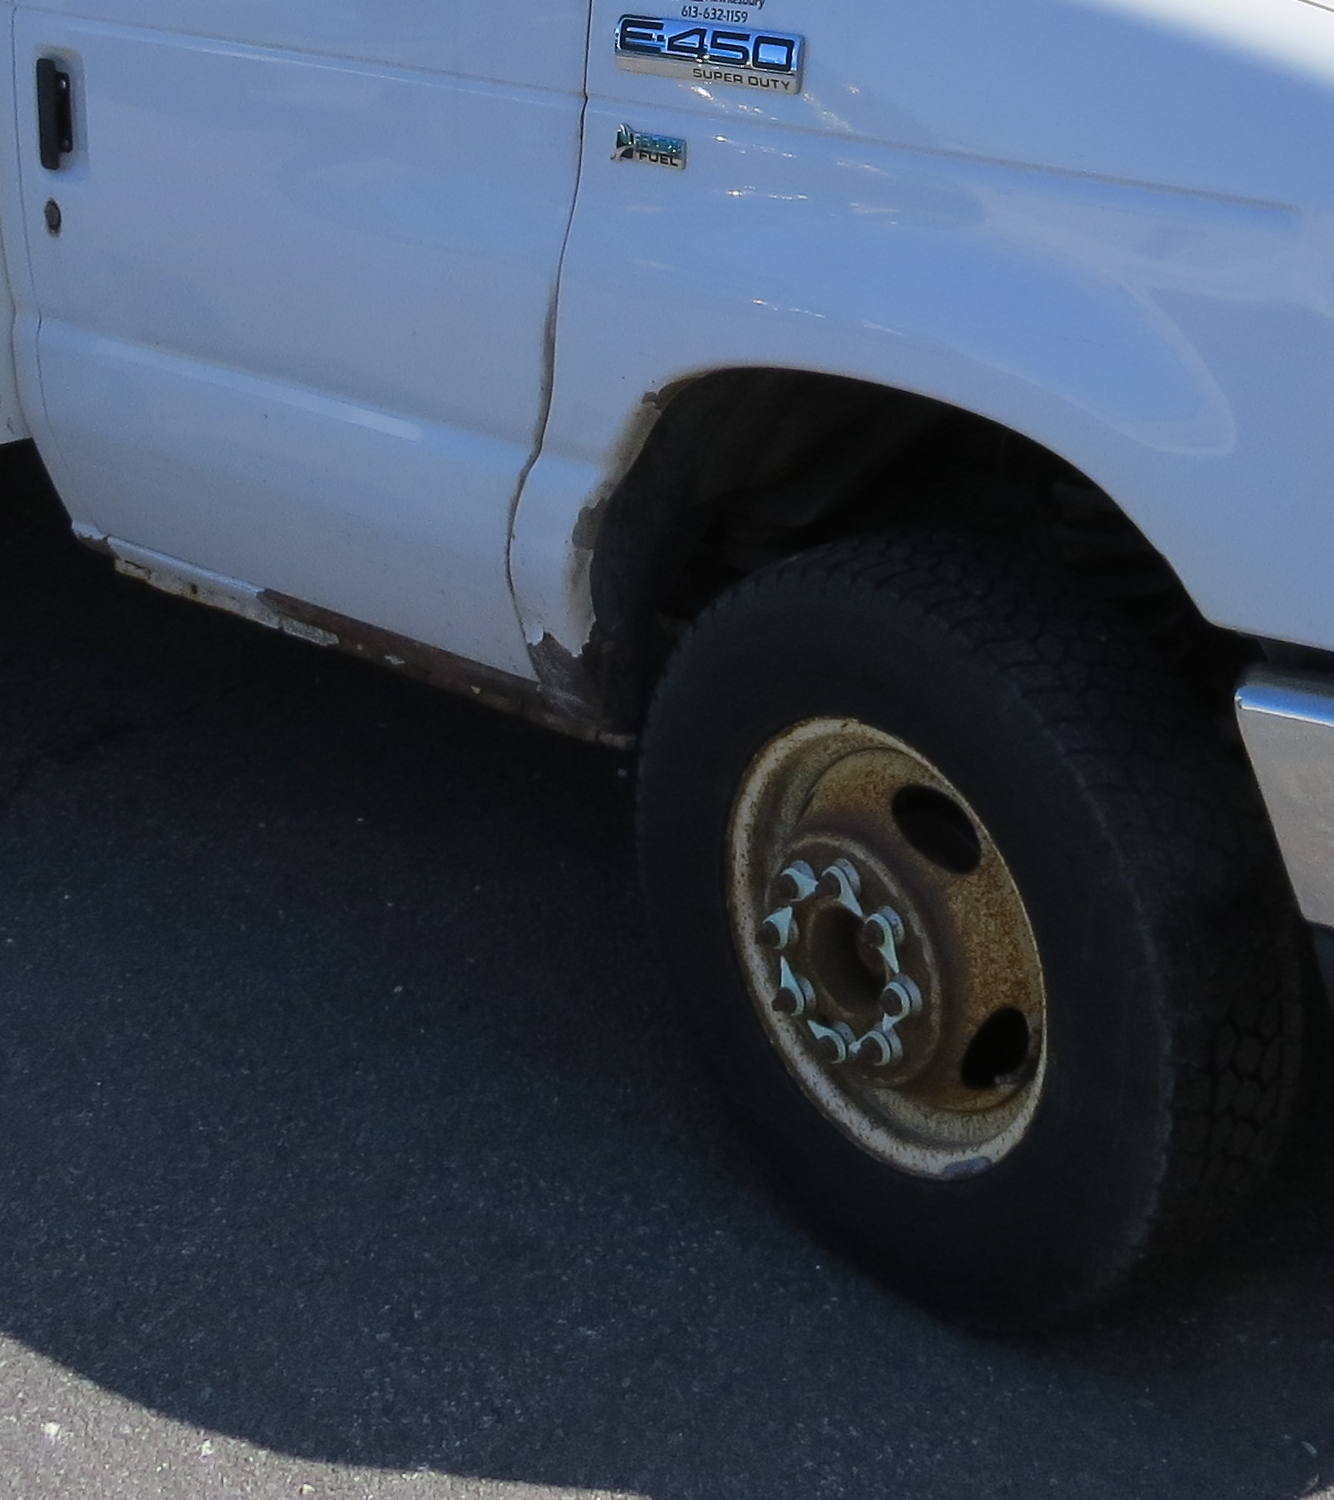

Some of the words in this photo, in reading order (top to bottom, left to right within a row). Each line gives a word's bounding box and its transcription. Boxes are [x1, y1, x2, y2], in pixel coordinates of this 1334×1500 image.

[680, 5, 749, 24] 613-632-1159
[691, 68, 744, 85] SUPER
[747, 75, 791, 92] DUTY
[638, 149, 679, 168] FUEL
